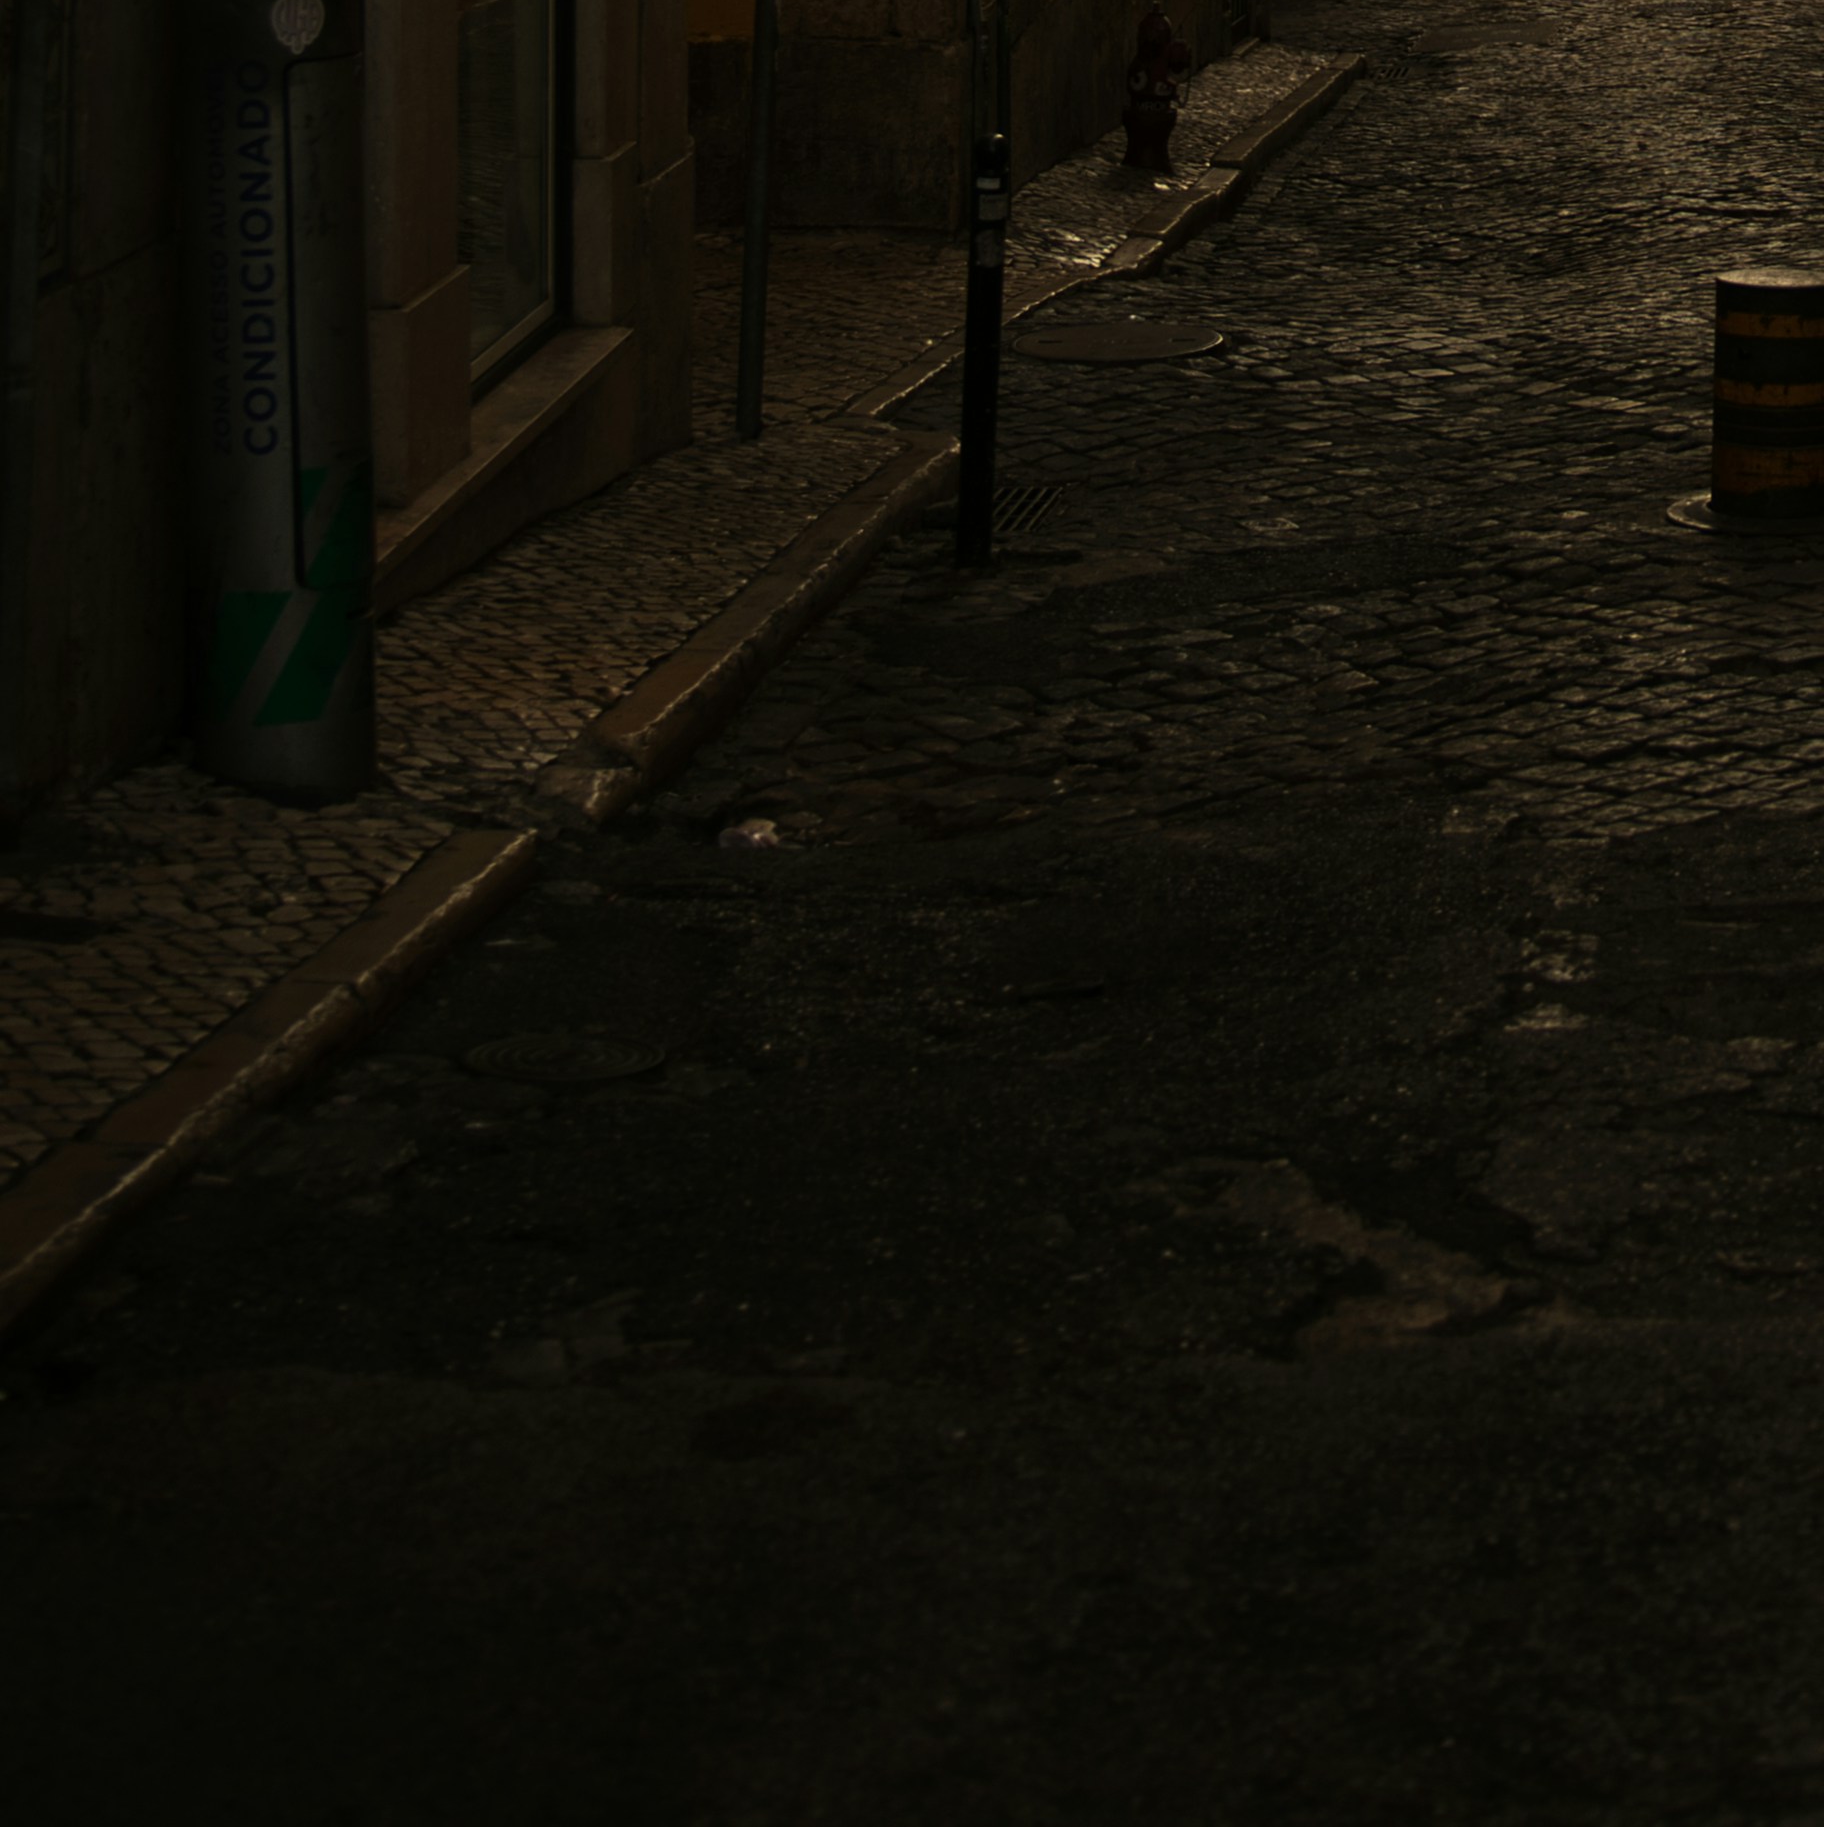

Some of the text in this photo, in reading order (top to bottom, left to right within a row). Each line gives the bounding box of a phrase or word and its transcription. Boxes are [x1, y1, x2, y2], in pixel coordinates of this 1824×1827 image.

[209, 250, 231, 364] ACESSO
[237, 60, 279, 455] CONDICIONADO
[212, 374, 232, 456] ZONA
